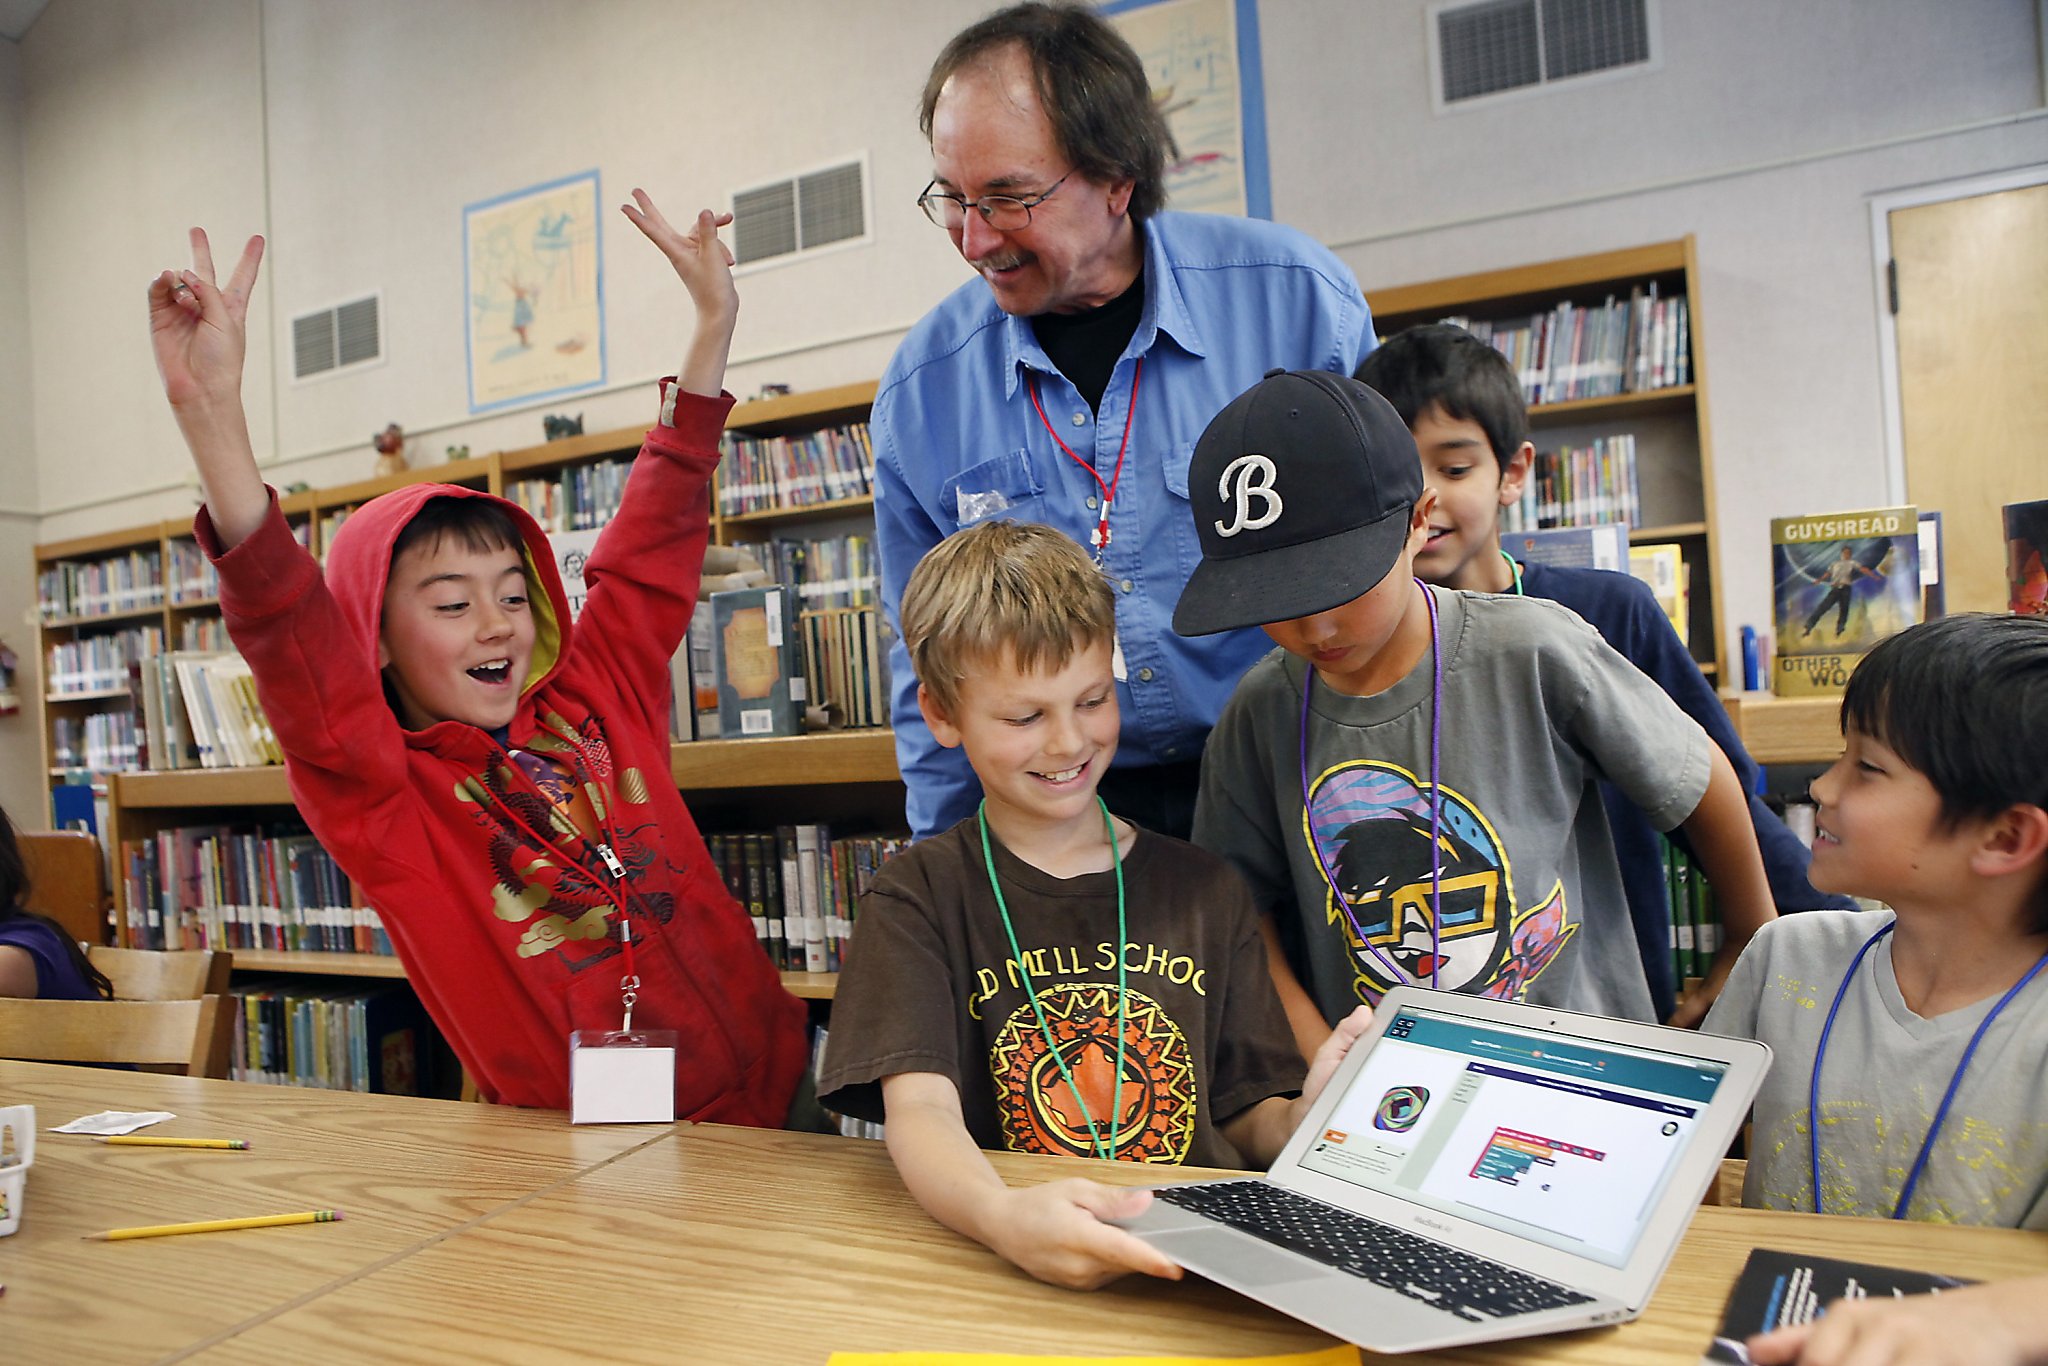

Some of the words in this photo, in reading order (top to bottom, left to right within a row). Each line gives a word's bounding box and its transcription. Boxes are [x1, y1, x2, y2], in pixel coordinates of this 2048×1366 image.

[1214, 454, 1283, 538] B
[1782, 656, 1842, 672] OTHER
[1005, 946, 1090, 989] MILL
